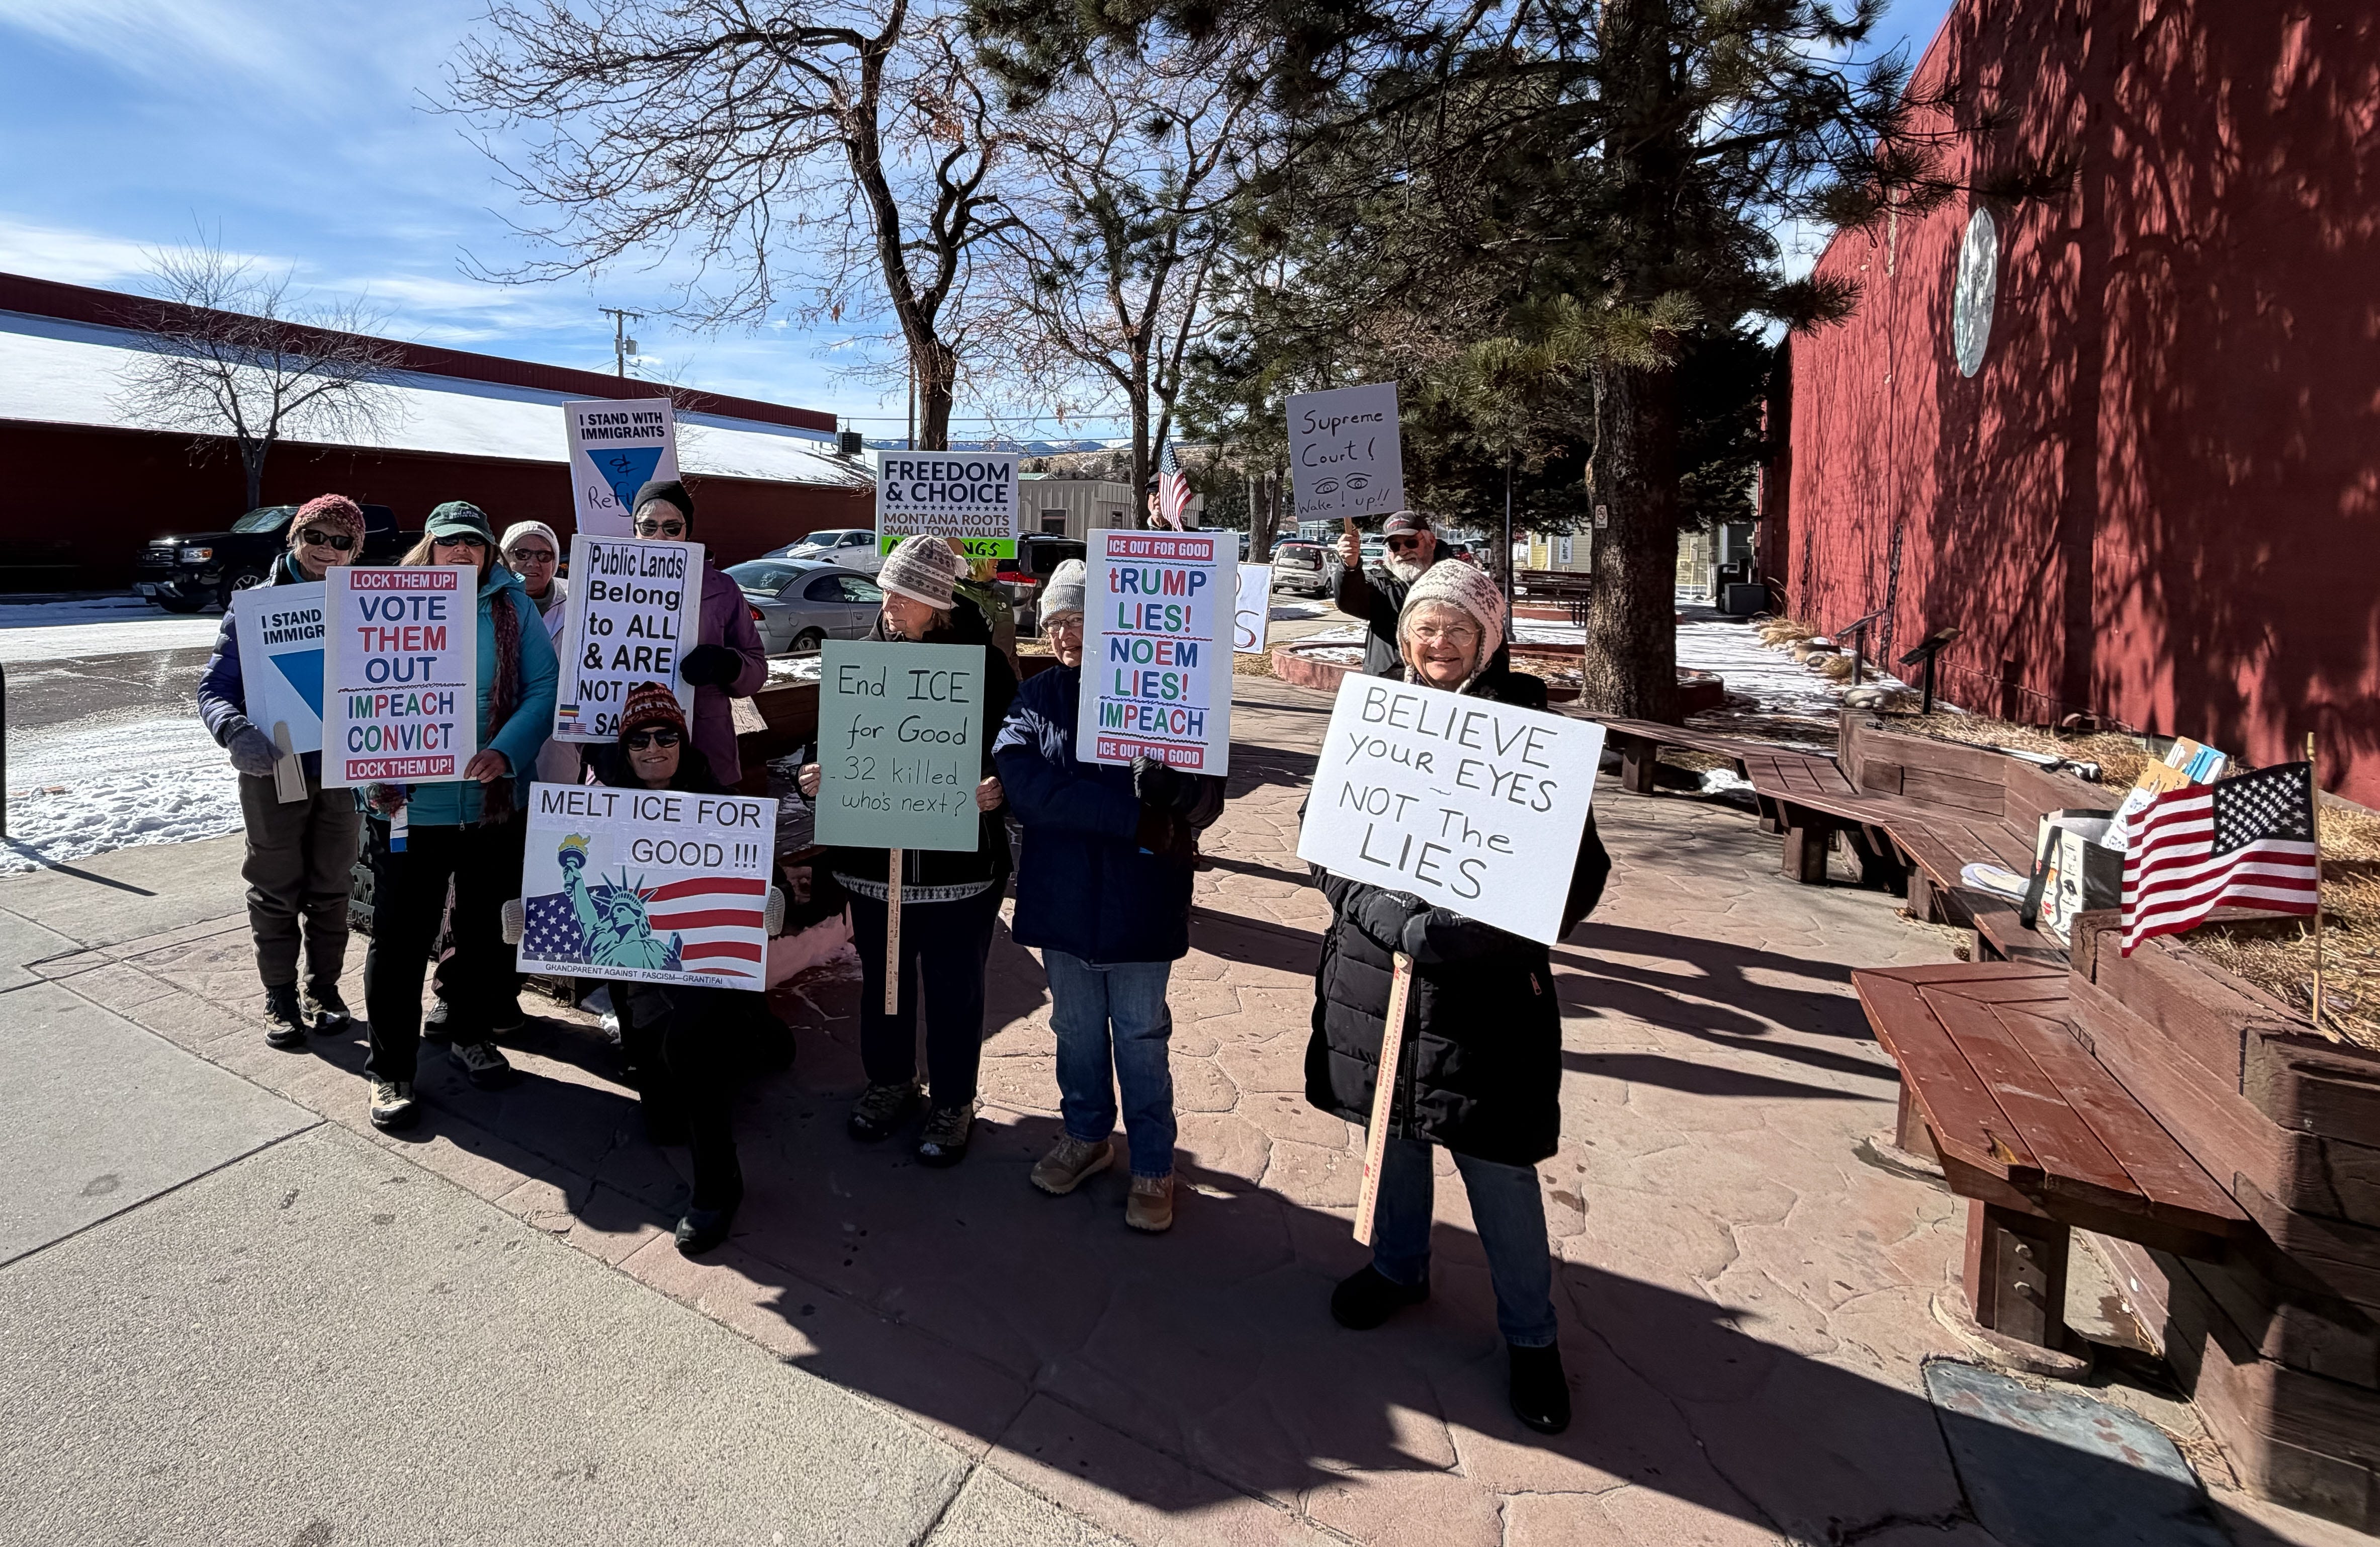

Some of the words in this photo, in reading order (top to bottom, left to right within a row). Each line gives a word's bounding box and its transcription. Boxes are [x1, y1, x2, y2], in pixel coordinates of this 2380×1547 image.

[580, 414, 584, 426] I
[588, 412, 629, 425] STAND
[631, 411, 663, 424] WITH
[1301, 409, 1383, 437] Supreme
[581, 425, 665, 441] IMMIGRANTS
[885, 460, 1010, 483] FREEDOM
[886, 481, 904, 502] &
[911, 482, 1008, 503] CHOICE
[884, 513, 958, 525] MONTANA
[962, 514, 1010, 526] ROOTS
[884, 525, 920, 537] SMALL
[924, 527, 963, 537] TOWN
[964, 527, 1010, 538] VALUES
[591, 545, 637, 576] Public
[640, 549, 683, 579] Lands
[1109, 540, 1126, 553] ICE
[1129, 541, 1151, 554] OUT
[1154, 542, 1175, 556] FOR
[1179, 543, 1209, 557] GOOD
[354, 574, 390, 588] LOCK
[394, 574, 429, 587] THEM
[433, 573, 454, 587] UP!
[359, 596, 447, 622] VOTE
[589, 580, 680, 611] Belong
[261, 615, 267, 629] I
[272, 609, 322, 628] STAND
[589, 612, 613, 636] to
[627, 615, 676, 640] ALL
[1118, 601, 1191, 633] LIES!
[358, 626, 446, 652] THEM
[1110, 637, 1198, 668] NOEM
[365, 657, 437, 683] OUT
[583, 643, 603, 669] &
[611, 644, 672, 673] ARE
[579, 679, 623, 702] NOT
[839, 665, 887, 698] End
[907, 669, 970, 703] ICE
[1115, 668, 1188, 701] LIES!
[348, 692, 454, 719] IMPEACH
[1099, 702, 1203, 737] IMPEACH
[347, 723, 454, 753] CONVICT
[847, 714, 885, 749] for
[898, 715, 967, 745] Good
[1362, 686, 1558, 769] BELIEVE
[1099, 742, 1116, 755] ICE
[1119, 744, 1141, 757] OUT
[1169, 749, 1199, 765] GOOD
[349, 762, 386, 778] LOCK
[391, 761, 426, 776] THEM
[431, 758, 452, 775] UP!
[844, 756, 875, 781] 32
[893, 757, 957, 786] killed
[1456, 758, 1557, 813] EYES
[541, 790, 620, 817] MELT
[633, 795, 682, 822] ICE
[697, 800, 761, 828] FOR
[842, 790, 891, 811] who's
[902, 791, 967, 817] next?
[1339, 781, 1420, 822] NOT
[1439, 808, 1514, 854] The
[632, 838, 723, 867] GOOD
[735, 843, 757, 868] !!!
[1359, 823, 1487, 900] LIES
[546, 964, 602, 975] GRANDPARENT
[604, 969, 638, 978] AGAINST
